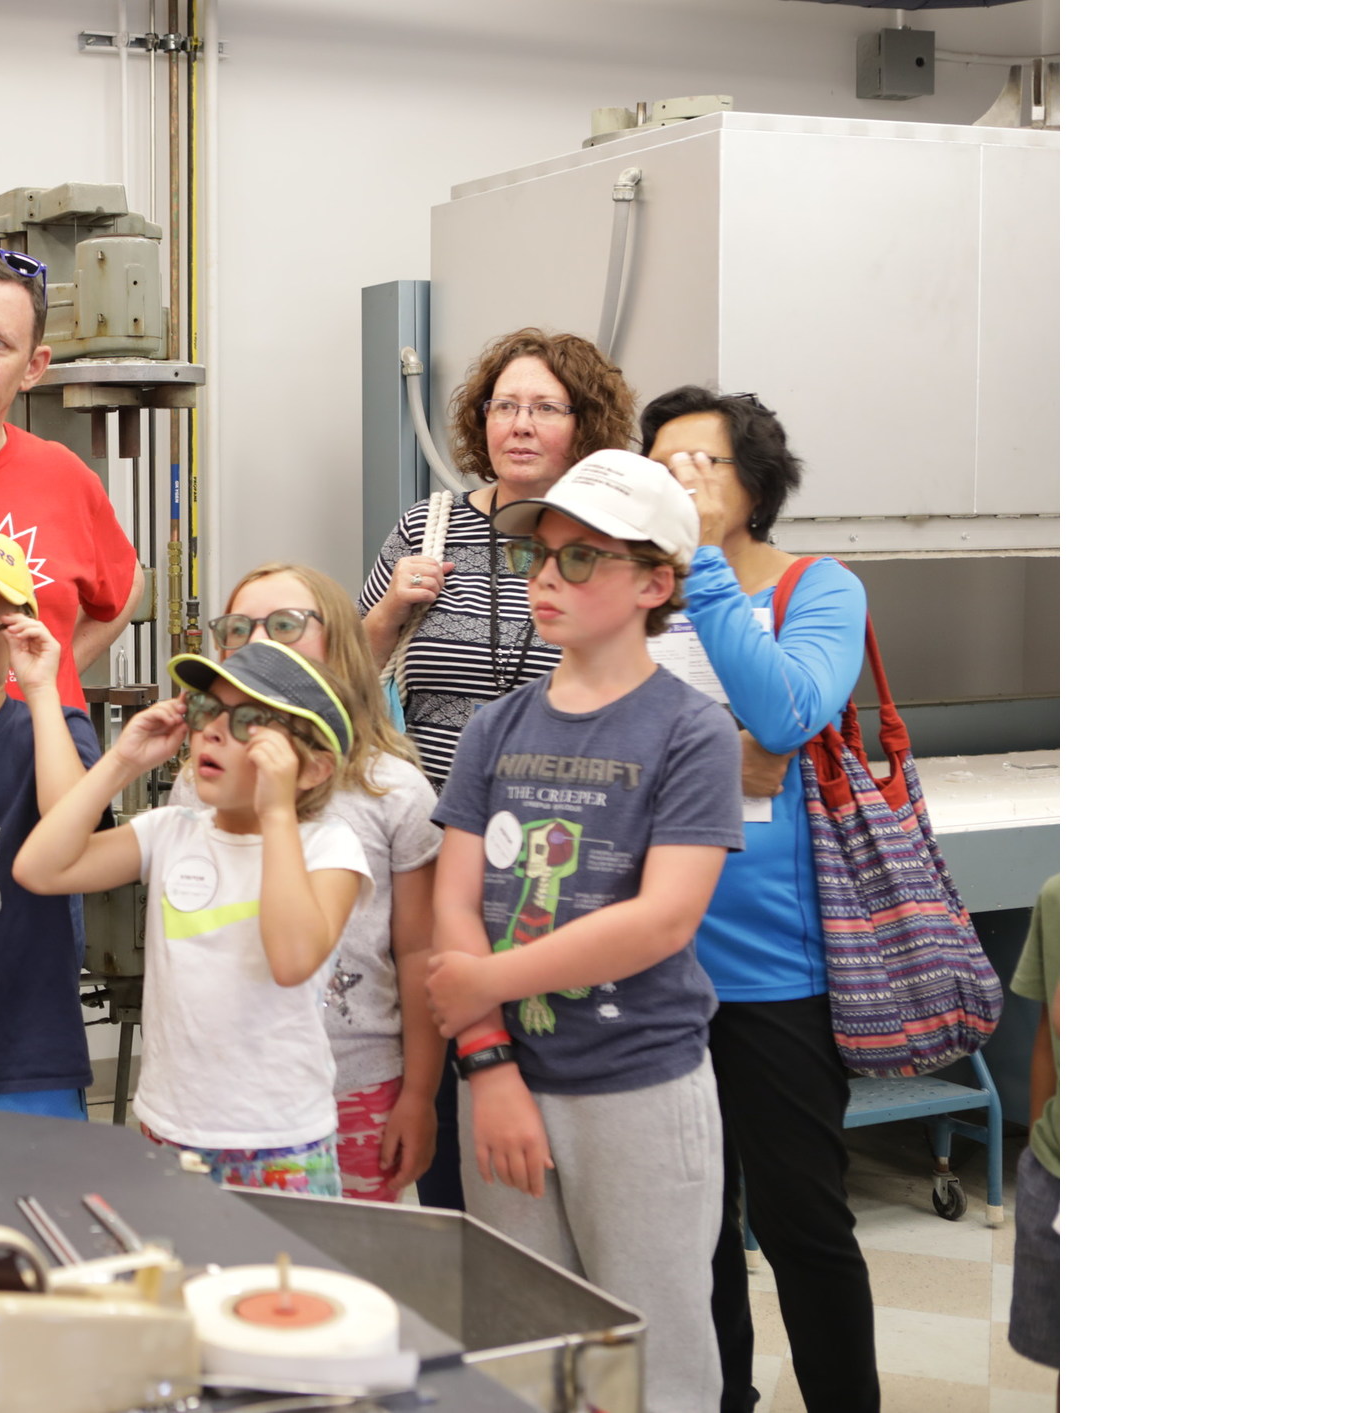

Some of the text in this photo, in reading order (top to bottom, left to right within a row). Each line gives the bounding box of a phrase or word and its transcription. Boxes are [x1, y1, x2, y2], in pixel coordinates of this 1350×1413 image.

[497, 754, 642, 790] MINECRAFT
[507, 786, 607, 806] THE CREEPER
